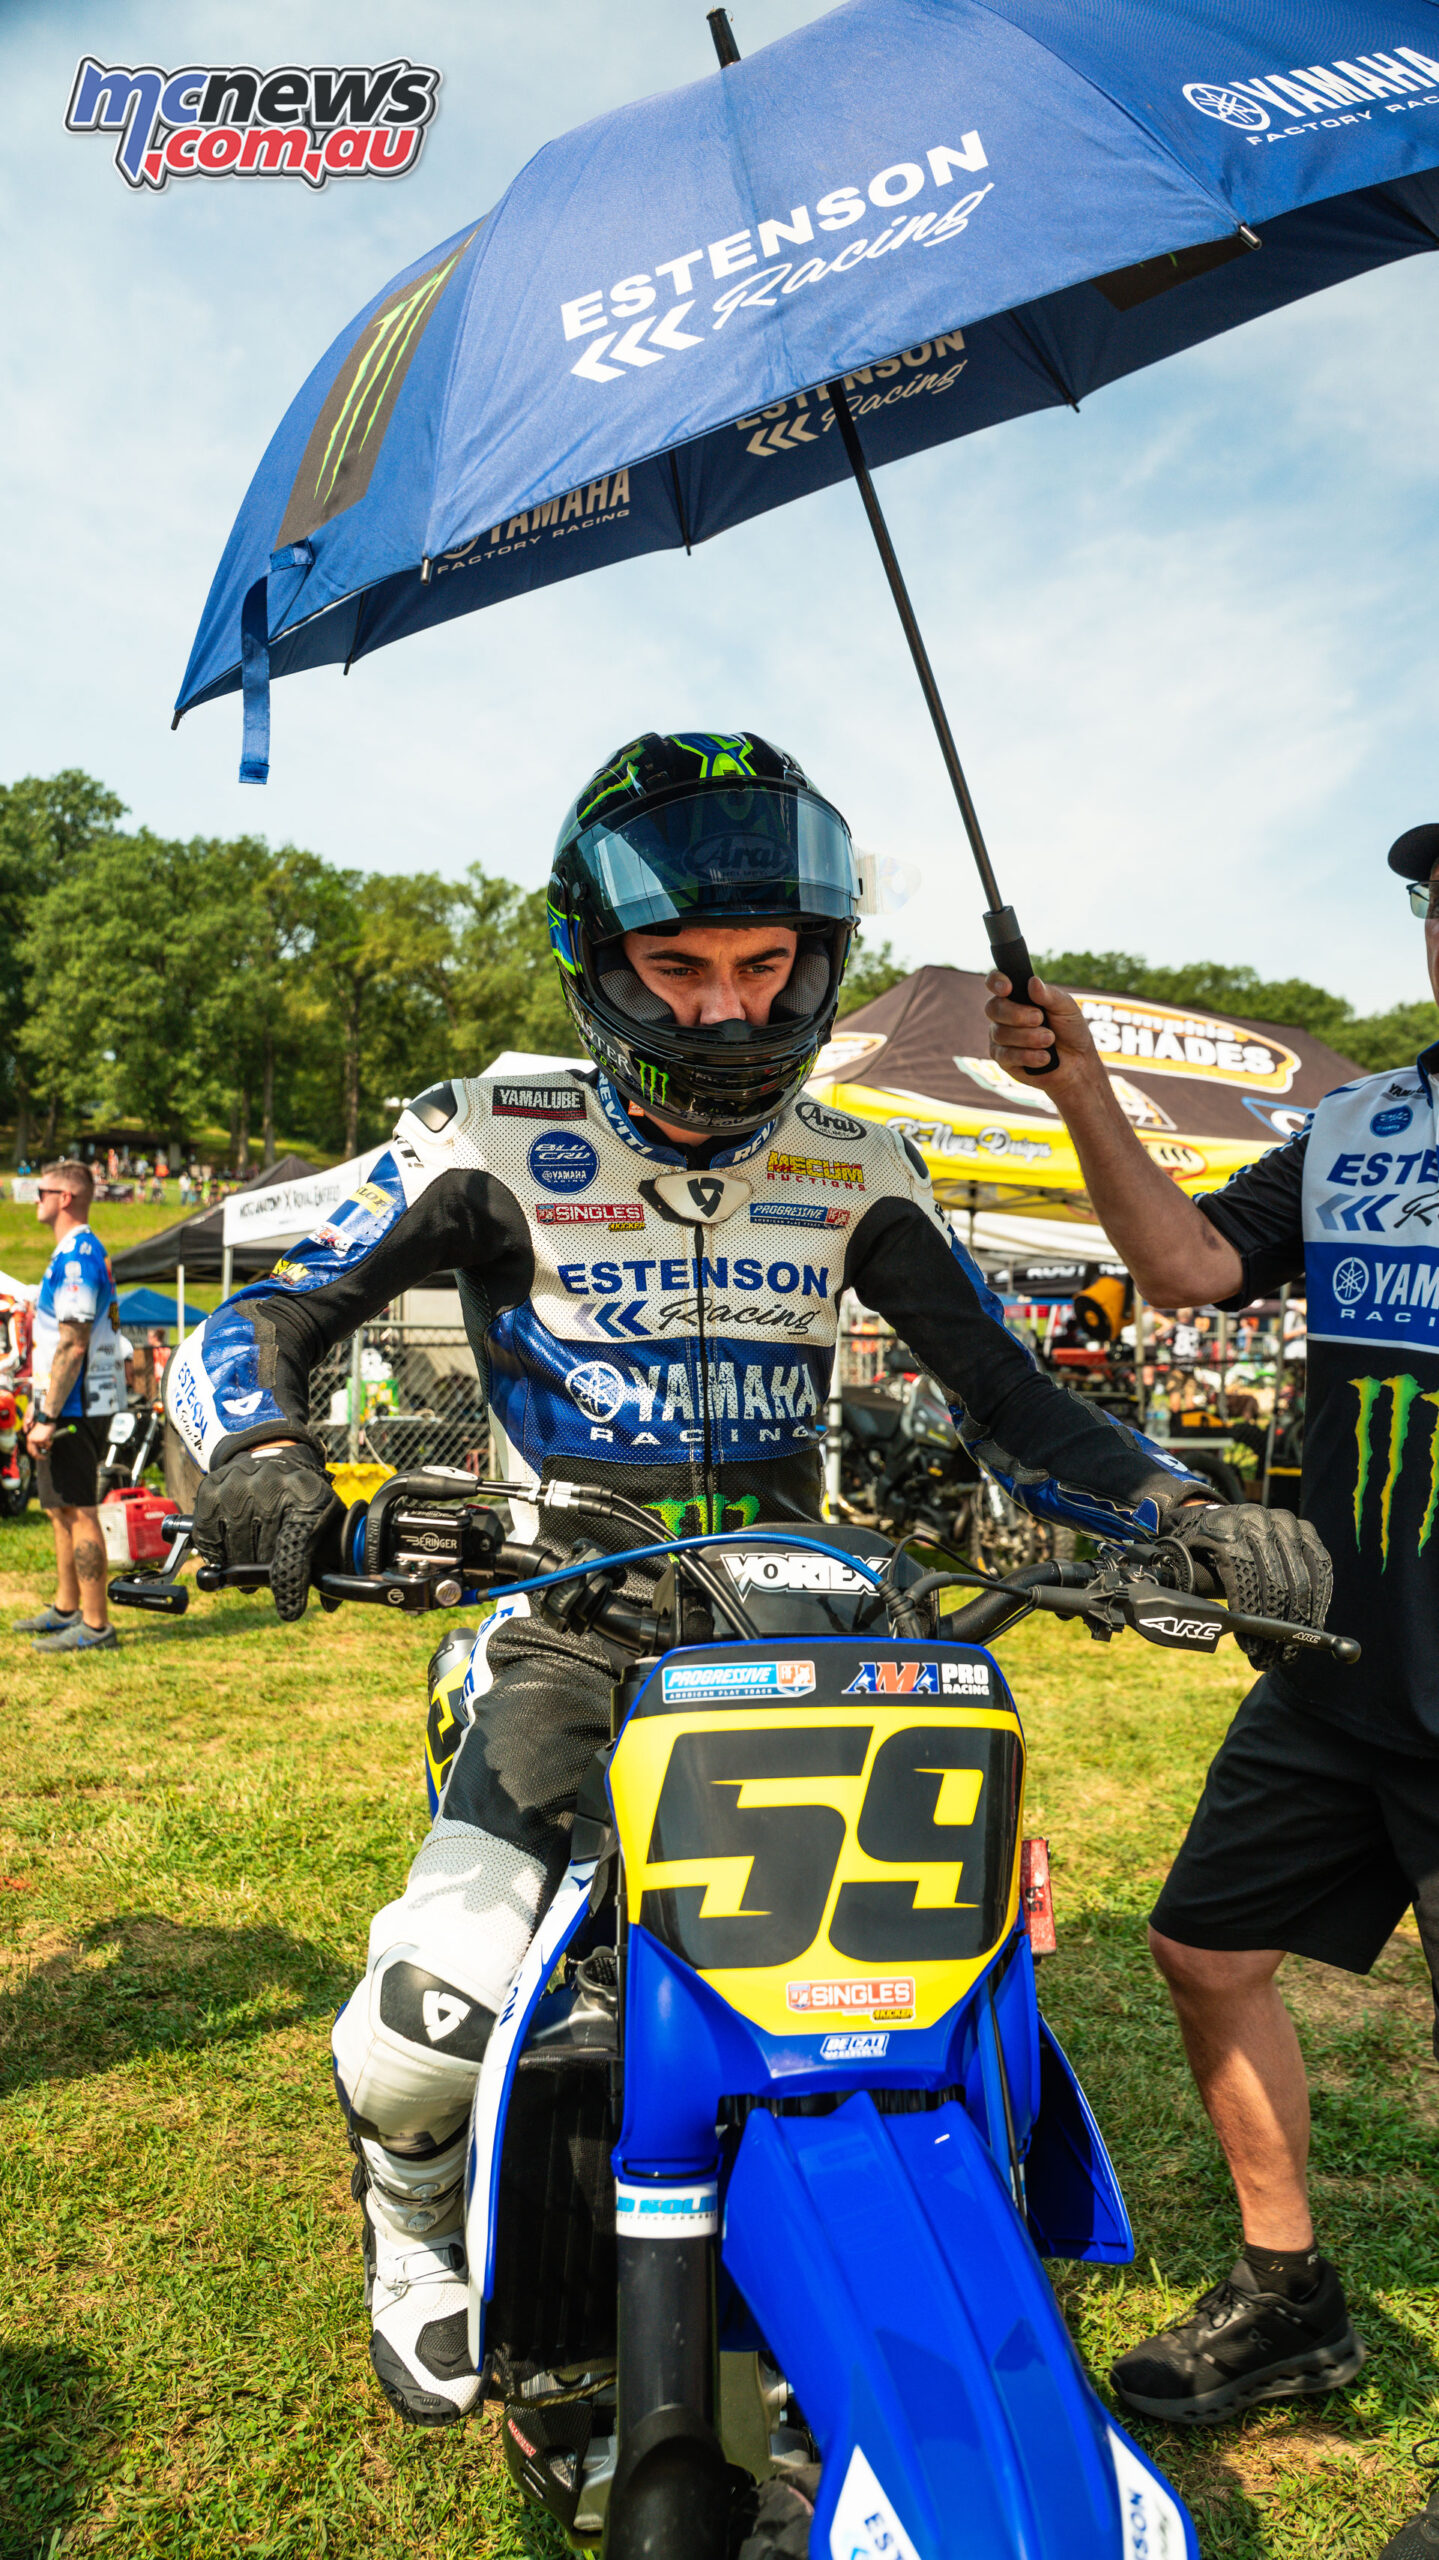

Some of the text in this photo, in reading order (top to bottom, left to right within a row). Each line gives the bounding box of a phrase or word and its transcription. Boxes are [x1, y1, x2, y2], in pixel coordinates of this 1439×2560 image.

[1229, 47, 1439, 117] YAMAHA
[1246, 111, 1372, 145] FACTORY
[561, 130, 988, 341] ESTENSON
[712, 183, 994, 330] Racing
[437, 509, 629, 574] FACTORY RACING
[1082, 1002, 1236, 1042] Memphis
[1088, 1020, 1276, 1075] SHADES
[500, 1088, 581, 1109] YAMALUBE
[802, 1106, 858, 1133] Arai
[535, 1143, 587, 1151] BLU
[539, 1152, 591, 1160] CRU
[552, 1169, 587, 1180] YAMAHA
[767, 1151, 865, 1184] MECUM
[767, 1172, 867, 1192] AUCTIONS
[556, 1206, 641, 1221] SINGLES
[753, 1205, 826, 1220] PROGRESSIVE
[557, 1257, 829, 1299] ESTENSON
[658, 1297, 820, 1335] Racing
[628, 1360, 818, 1422] YAMAHA
[590, 1424, 810, 1446] RACING
[402, 1532, 457, 1552] BERINGER
[722, 1554, 888, 1598] VORTEX
[1139, 1616, 1222, 1640] ARC
[1292, 1631, 1321, 1644] ARC
[668, 1666, 772, 1687] PROGRESSIVE
[841, 1662, 988, 1694] AMA PRO
[942, 1683, 990, 1696] RACING
[669, 1688, 772, 1700] AMERICAN FLAT TRACK
[640, 1725, 1024, 1970] 59
[811, 1982, 910, 2006] SINGLES
[863, 2512, 906, 2560] ES
